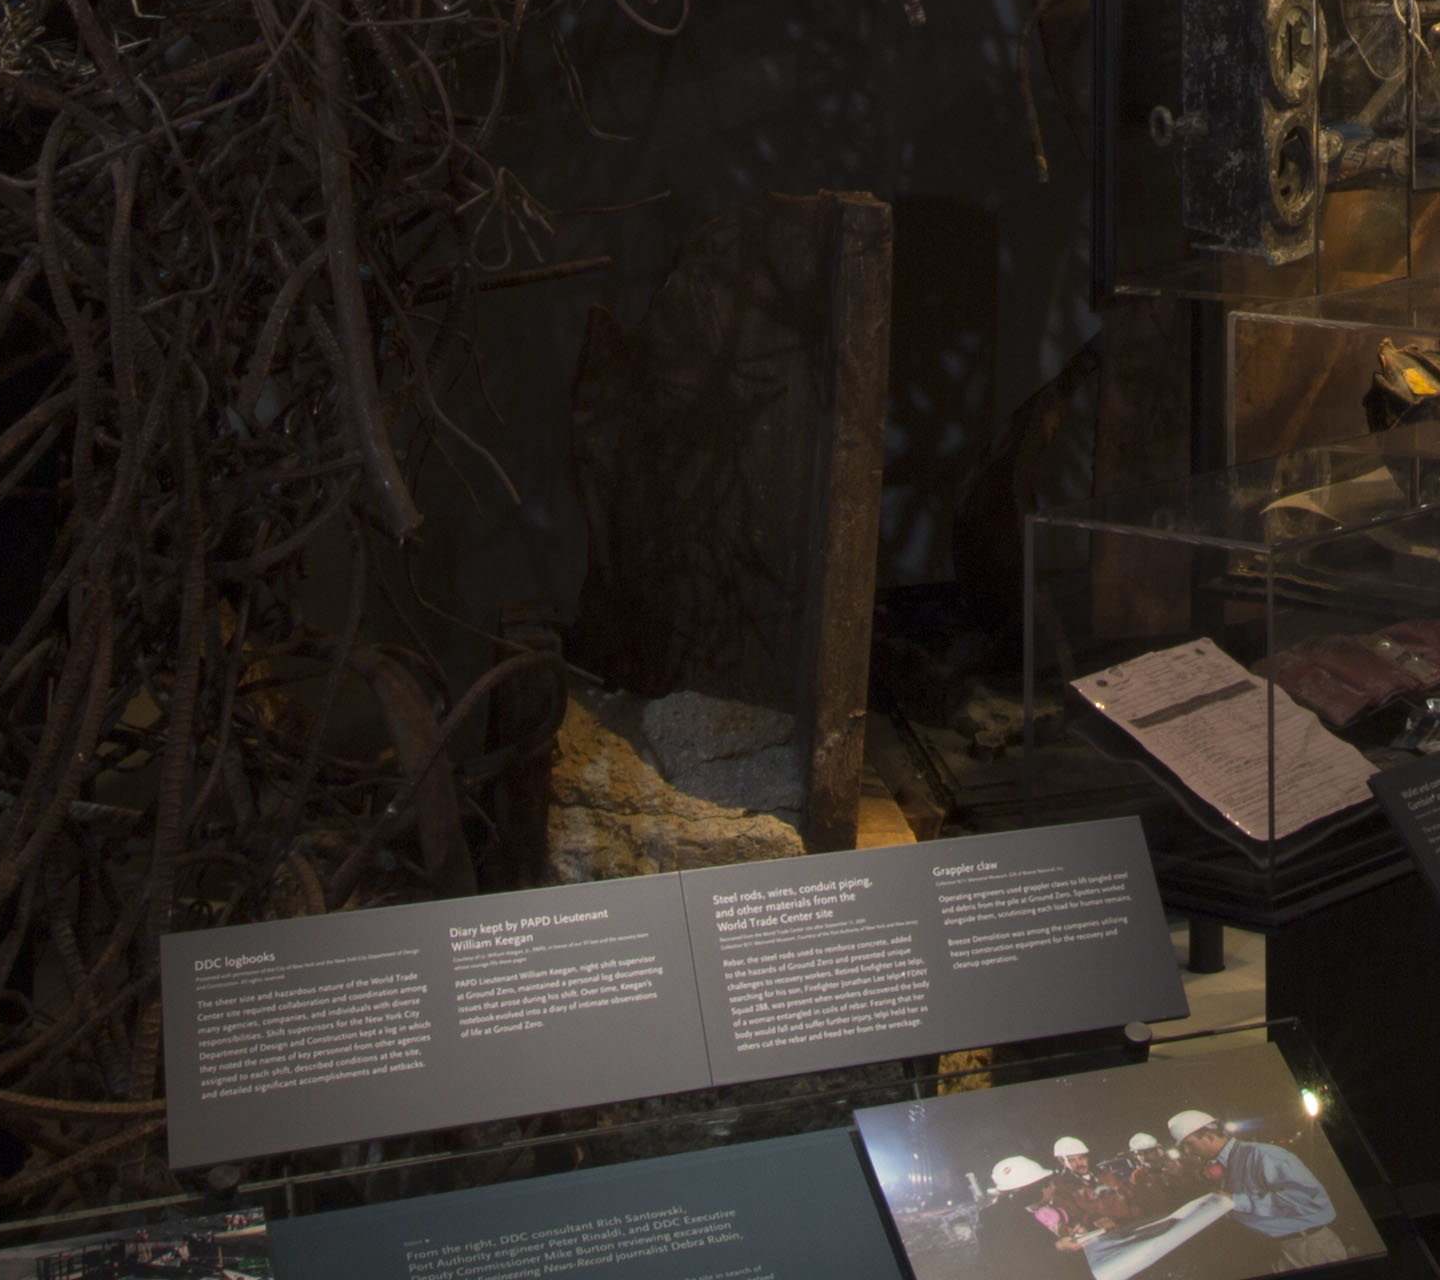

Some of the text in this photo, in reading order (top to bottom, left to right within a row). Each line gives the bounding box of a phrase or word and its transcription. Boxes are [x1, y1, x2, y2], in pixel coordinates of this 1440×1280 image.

[932, 860, 997, 877] Grappler claw
[712, 877, 872, 905] Steel rods, wires, conduit piping,
[715, 891, 855, 918] and other materials from the
[449, 909, 608, 937] Diary kept by PAPD Lieutenant
[716, 909, 833, 931] World Trade Center site
[451, 934, 533, 951] William Keegan
[194, 951, 275, 971] DDC logbooks
[455, 955, 655, 988] PAPD Lieutenant William Keegan, night shift supervisor
[196, 972, 417, 1008] The sheer size and hazardous nature of the World Trade
[456, 993, 464, 1001] at
[465, 988, 495, 999] Ground
[495, 986, 516, 995] Zero,
[517, 979, 560, 992] maintained
[567, 973, 600, 987] personal
[600, 973, 614, 982] log
[614, 966, 663, 979] documenting
[457, 1004, 482, 1012] issues
[483, 1001, 499, 1009] that
[499, 998, 520, 1007] arose
[521, 995, 547, 1004] during
[560, 989, 578, 999] shift.
[580, 987, 598, 996] Over
[599, 985, 619, 993] time,
[620, 979, 652, 991] Keegan's
[459, 1013, 494, 1025] notebook
[495, 1009, 524, 1021] evolved
[525, 1008, 541, 1016] into
[548, 1004, 567, 1013] diary
[568, 1000, 576, 1010] of
[577, 999, 609, 1008] intimate
[610, 992, 657, 1004] observations
[460, 1028, 469, 1038] of
[470, 1027, 482, 1036] life
[492, 1021, 522, 1033] Ground
[524, 1020, 544, 1029] Zero.
[405, 1205, 686, 1260] From the right, DDC consultant Rich Santowski,
[408, 1209, 735, 1272] Port Authority engineer Peter Rinaldi, and DDC Executive
[455, 1255, 540, 1276] Commissioner
[543, 1249, 572, 1261] Mike
[575, 1243, 614, 1255] Burton
[617, 1232, 671, 1248] reviewing
[673, 1222, 731, 1238] excavation
[543, 1252, 612, 1273] News-Record
[615, 1244, 668, 1262] journalist
[670, 1238, 704, 1250] Debra
[706, 1232, 743, 1243] Rubin,
